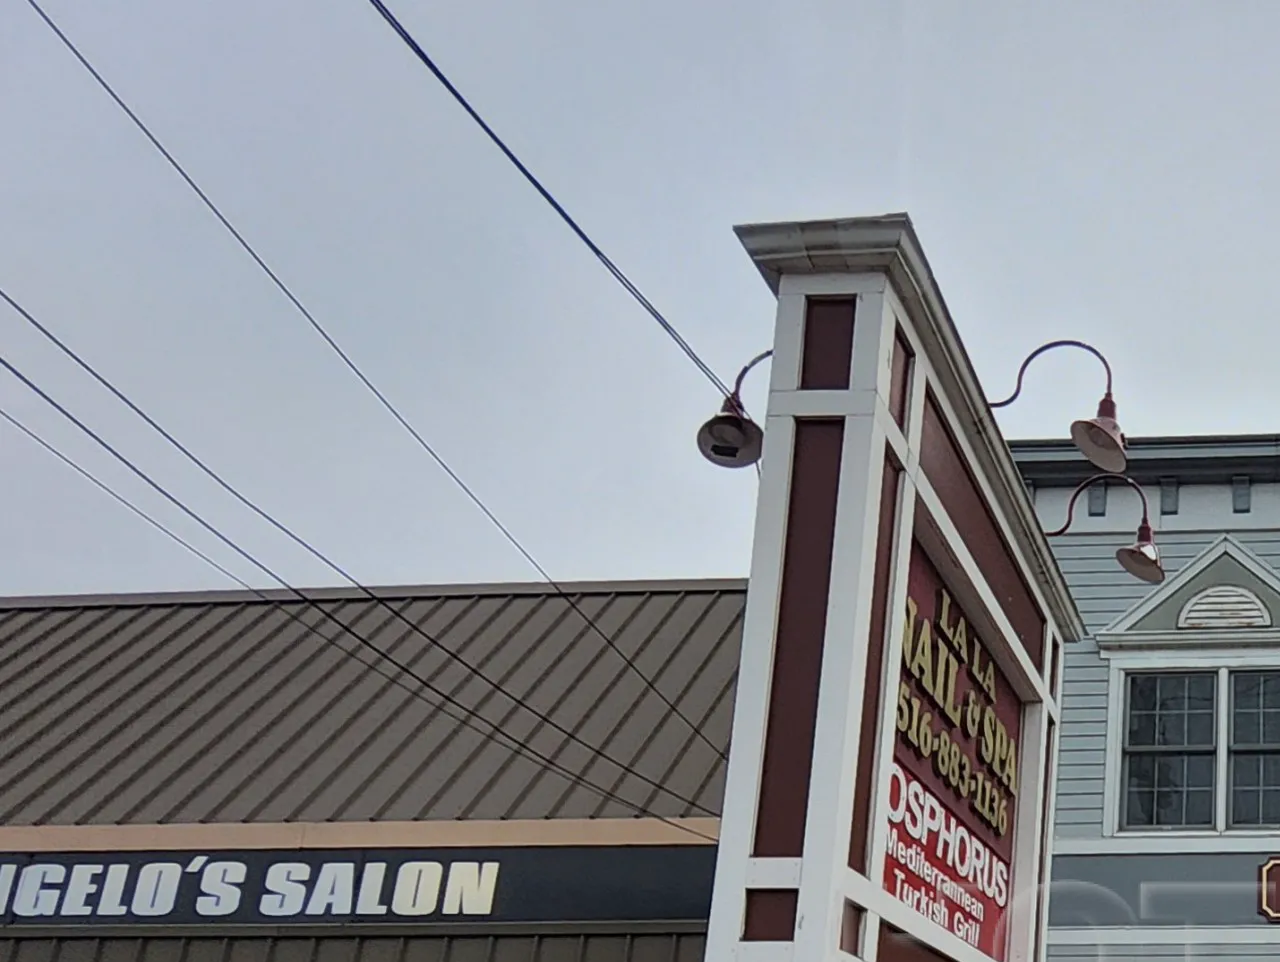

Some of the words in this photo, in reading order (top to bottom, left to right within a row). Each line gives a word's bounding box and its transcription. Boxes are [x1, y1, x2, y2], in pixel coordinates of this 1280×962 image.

[939, 588, 969, 665] LA
[972, 636, 997, 705] LA
[896, 680, 1008, 838] 516-883-1136
[966, 689, 981, 739] &
[982, 712, 1018, 797] SPA
[0, 855, 248, 917] GELO'S
[259, 860, 500, 917] SALON
[893, 867, 950, 929] Turkish
[953, 910, 981, 948] Grill
